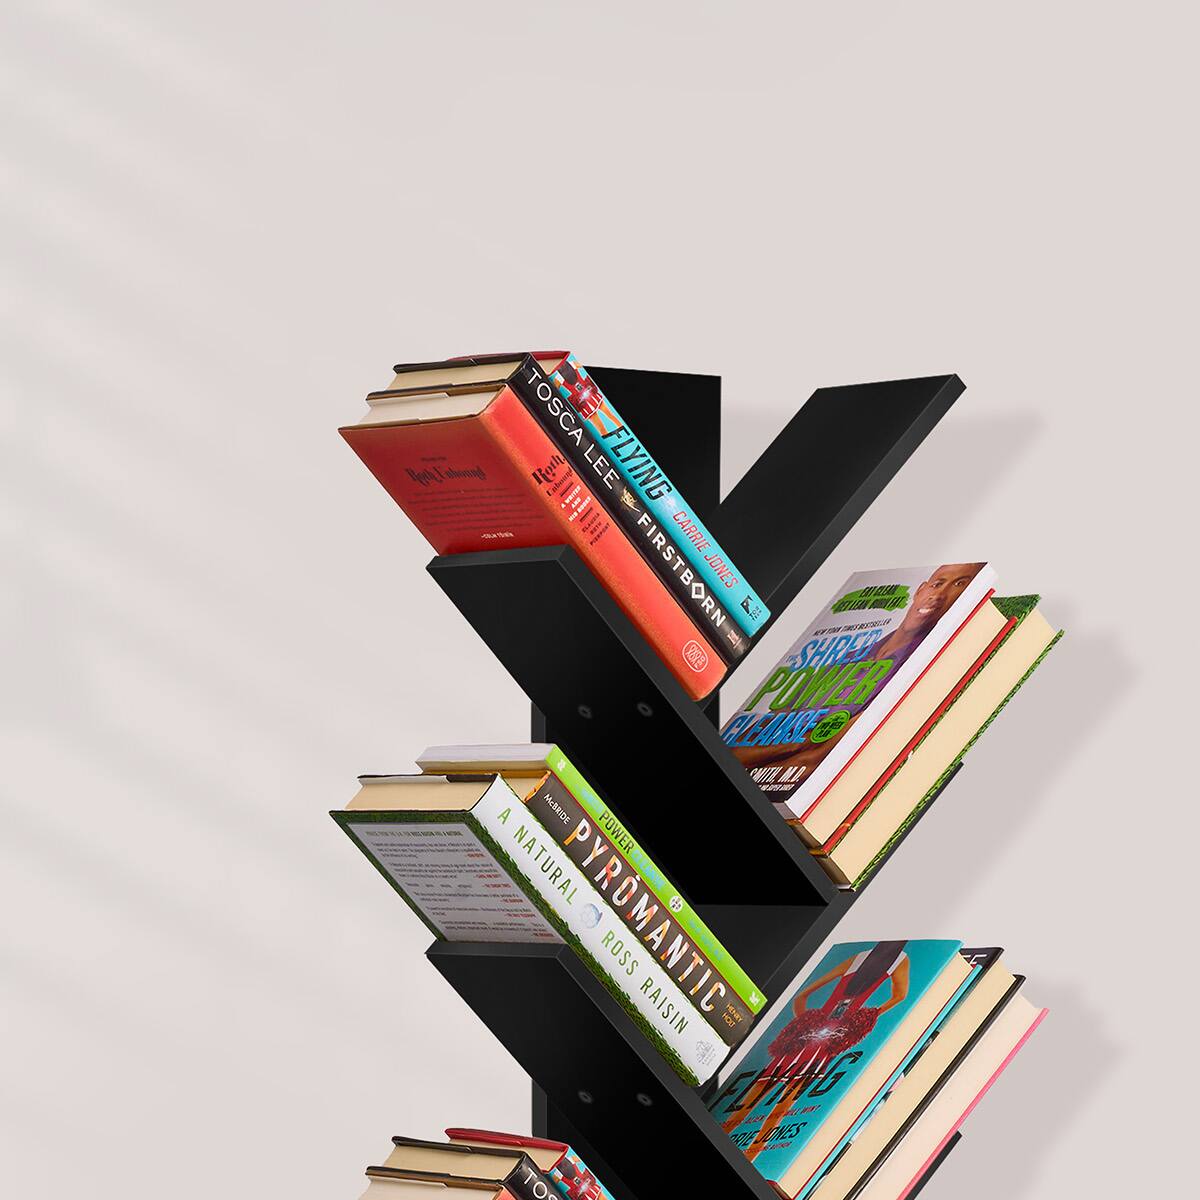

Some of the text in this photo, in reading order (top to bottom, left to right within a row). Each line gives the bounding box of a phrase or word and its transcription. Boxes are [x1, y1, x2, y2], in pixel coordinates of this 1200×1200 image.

[527, 368, 620, 490] TOSCA LEE
[601, 425, 672, 502] FLYING
[637, 513, 727, 628] FIRSTBORN
[672, 509, 739, 589] CARRIE JONES
[791, 628, 883, 673] SHRED
[744, 659, 894, 711] POWER
[721, 708, 829, 747] CLEANSE
[544, 793, 571, 825] McBRIDE
[599, 810, 635, 854] POWER
[498, 808, 576, 906] A NATURAL
[602, 930, 690, 1035] ROSS RAISIN
[722, 1013, 736, 1028] HOLT
[726, 1003, 744, 1023] HENRY
[708, 1051, 863, 1112] FLYING
[753, 1122, 808, 1145] JONES
